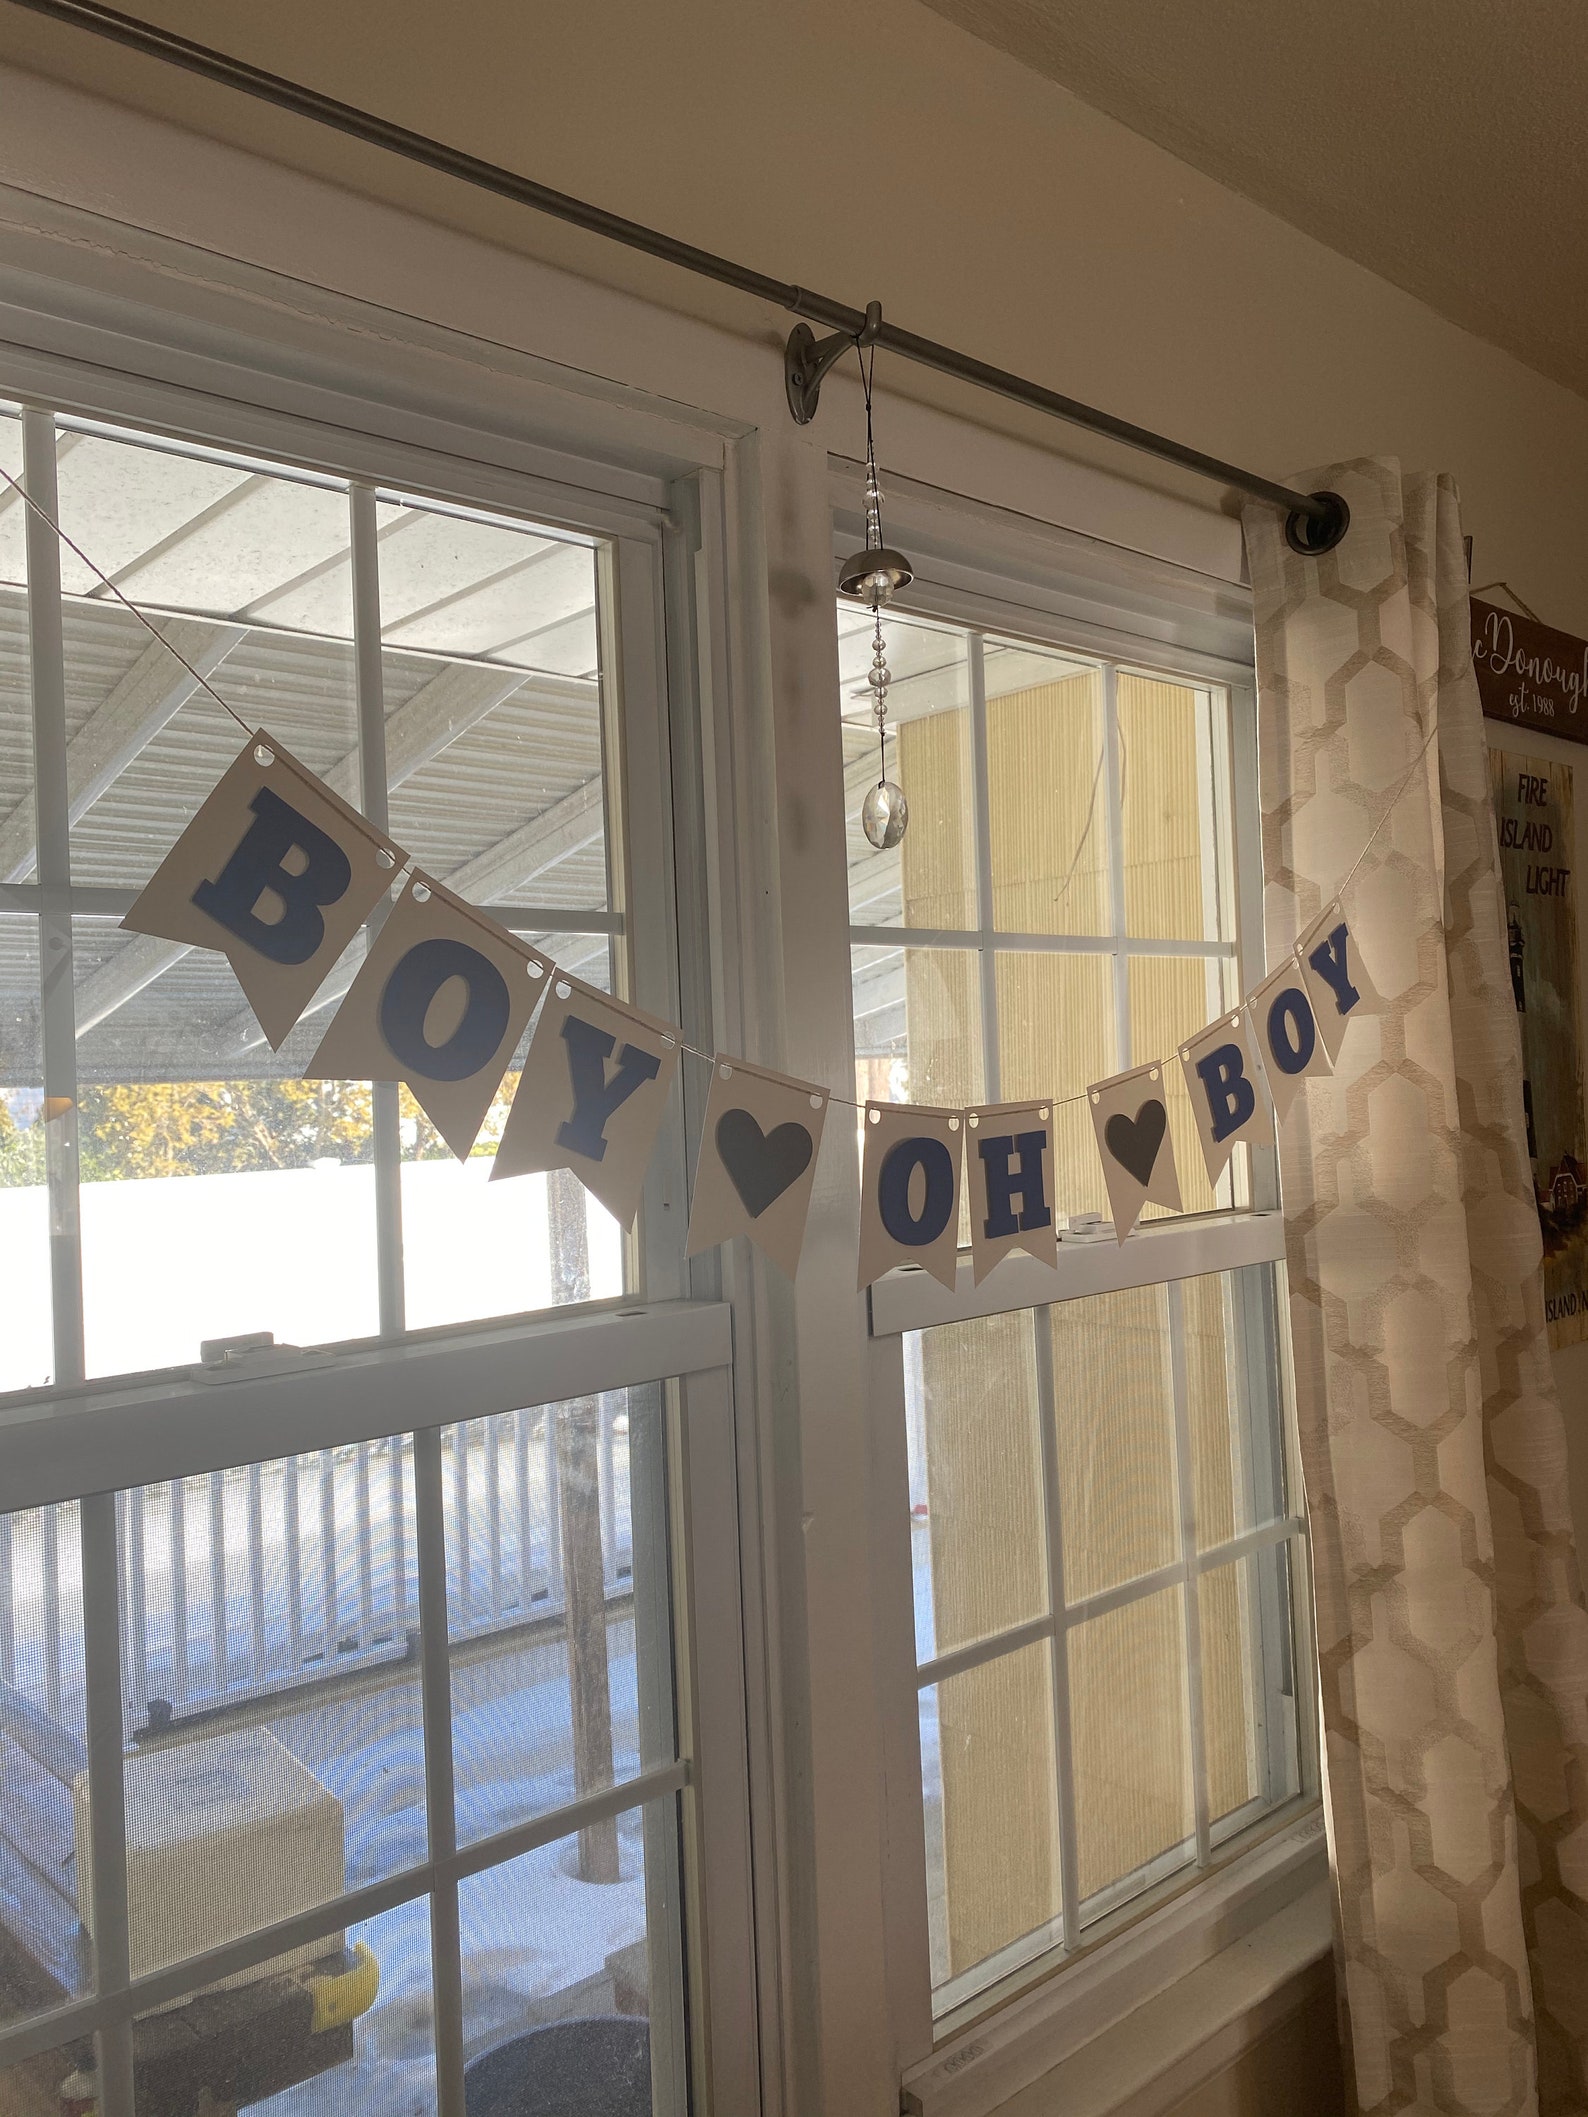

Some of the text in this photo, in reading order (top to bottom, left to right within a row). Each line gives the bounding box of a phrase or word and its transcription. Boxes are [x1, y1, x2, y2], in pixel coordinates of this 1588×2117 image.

[1473, 612, 1588, 714] cDonoug
[1509, 682, 1555, 717] est. 1988
[1518, 773, 1548, 807] FIRE
[1500, 816, 1552, 853] ISLAND
[1526, 865, 1570, 897] LIGHT
[191, 786, 1361, 1246] BOY OH BOY
